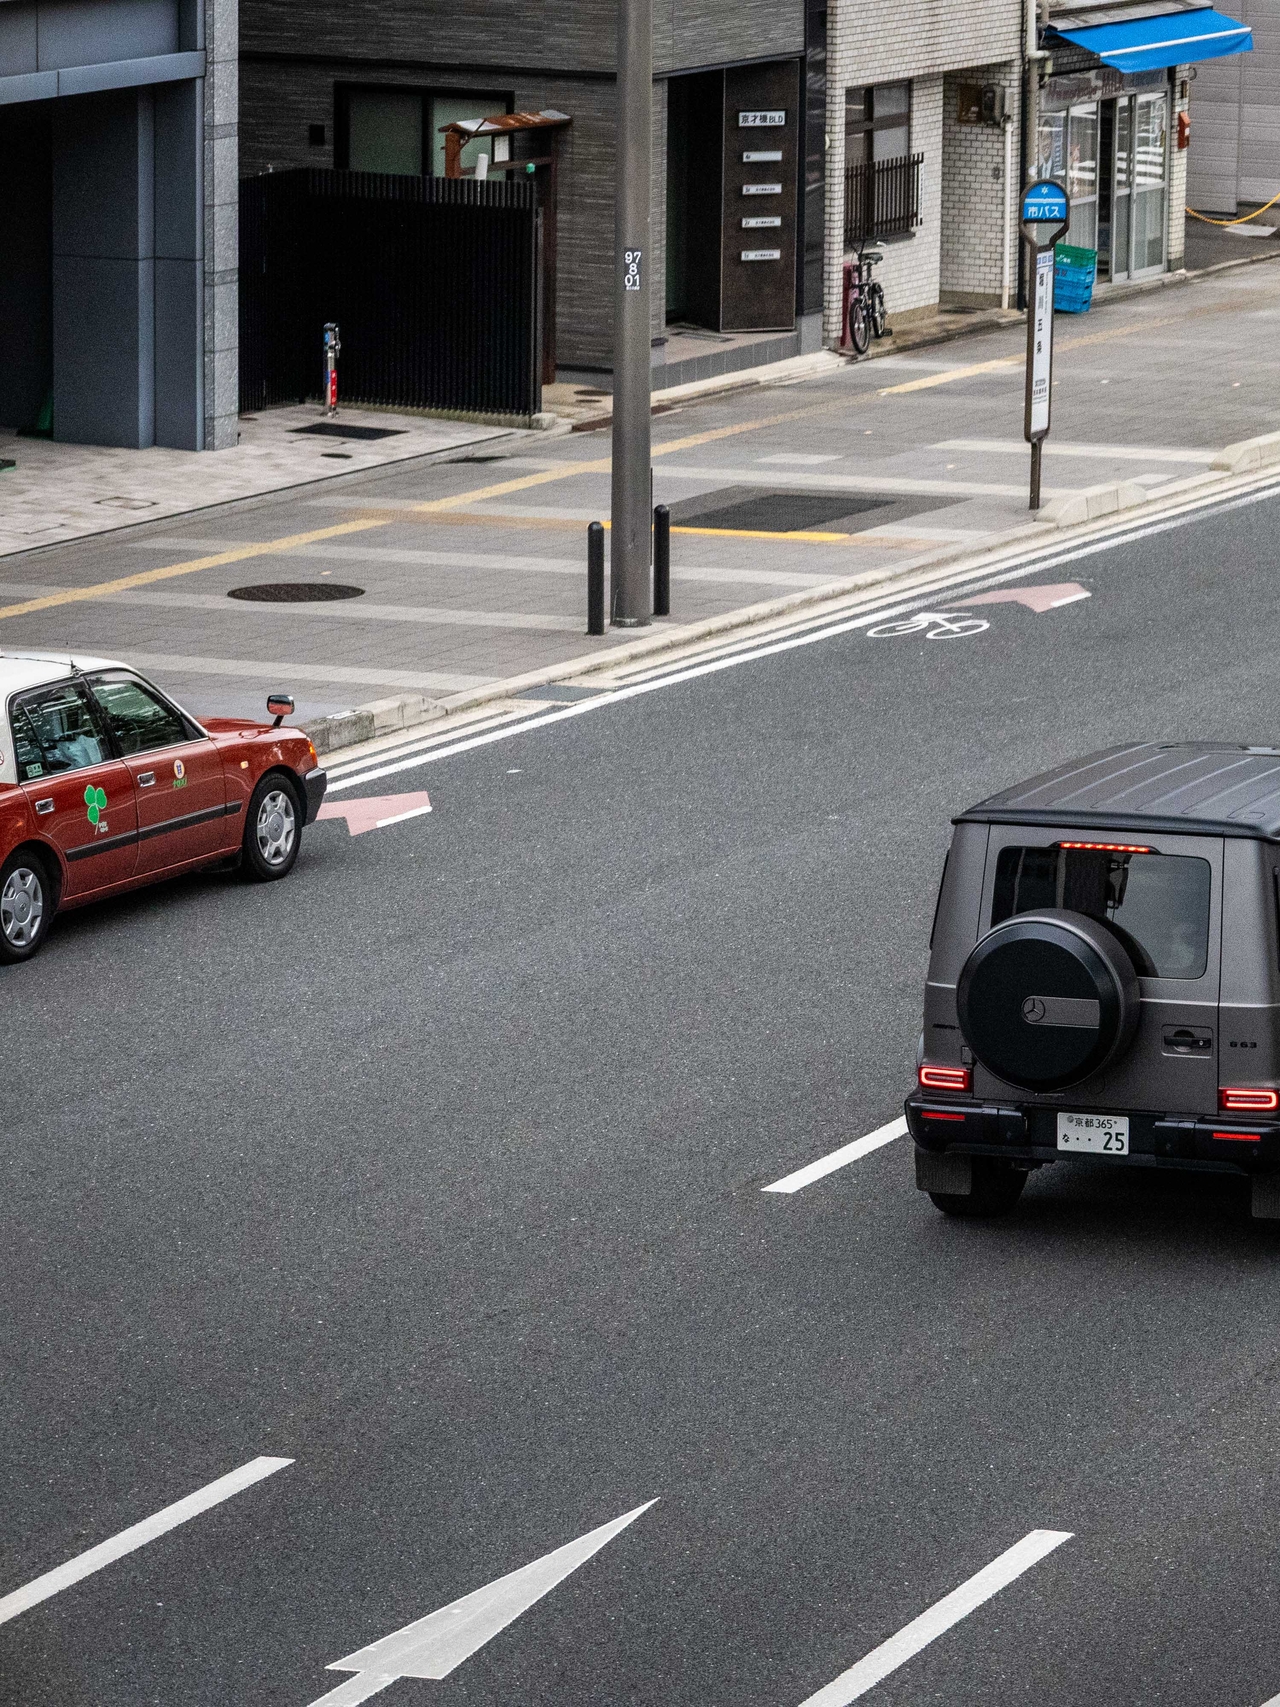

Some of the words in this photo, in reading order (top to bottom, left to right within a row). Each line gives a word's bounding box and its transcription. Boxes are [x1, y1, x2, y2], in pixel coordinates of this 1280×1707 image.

[1028, 206, 1060, 217] 市バス
[625, 251, 641, 264] 97
[629, 263, 637, 275] 8
[625, 274, 640, 286] 01
[1103, 1131, 1125, 1151] 25
